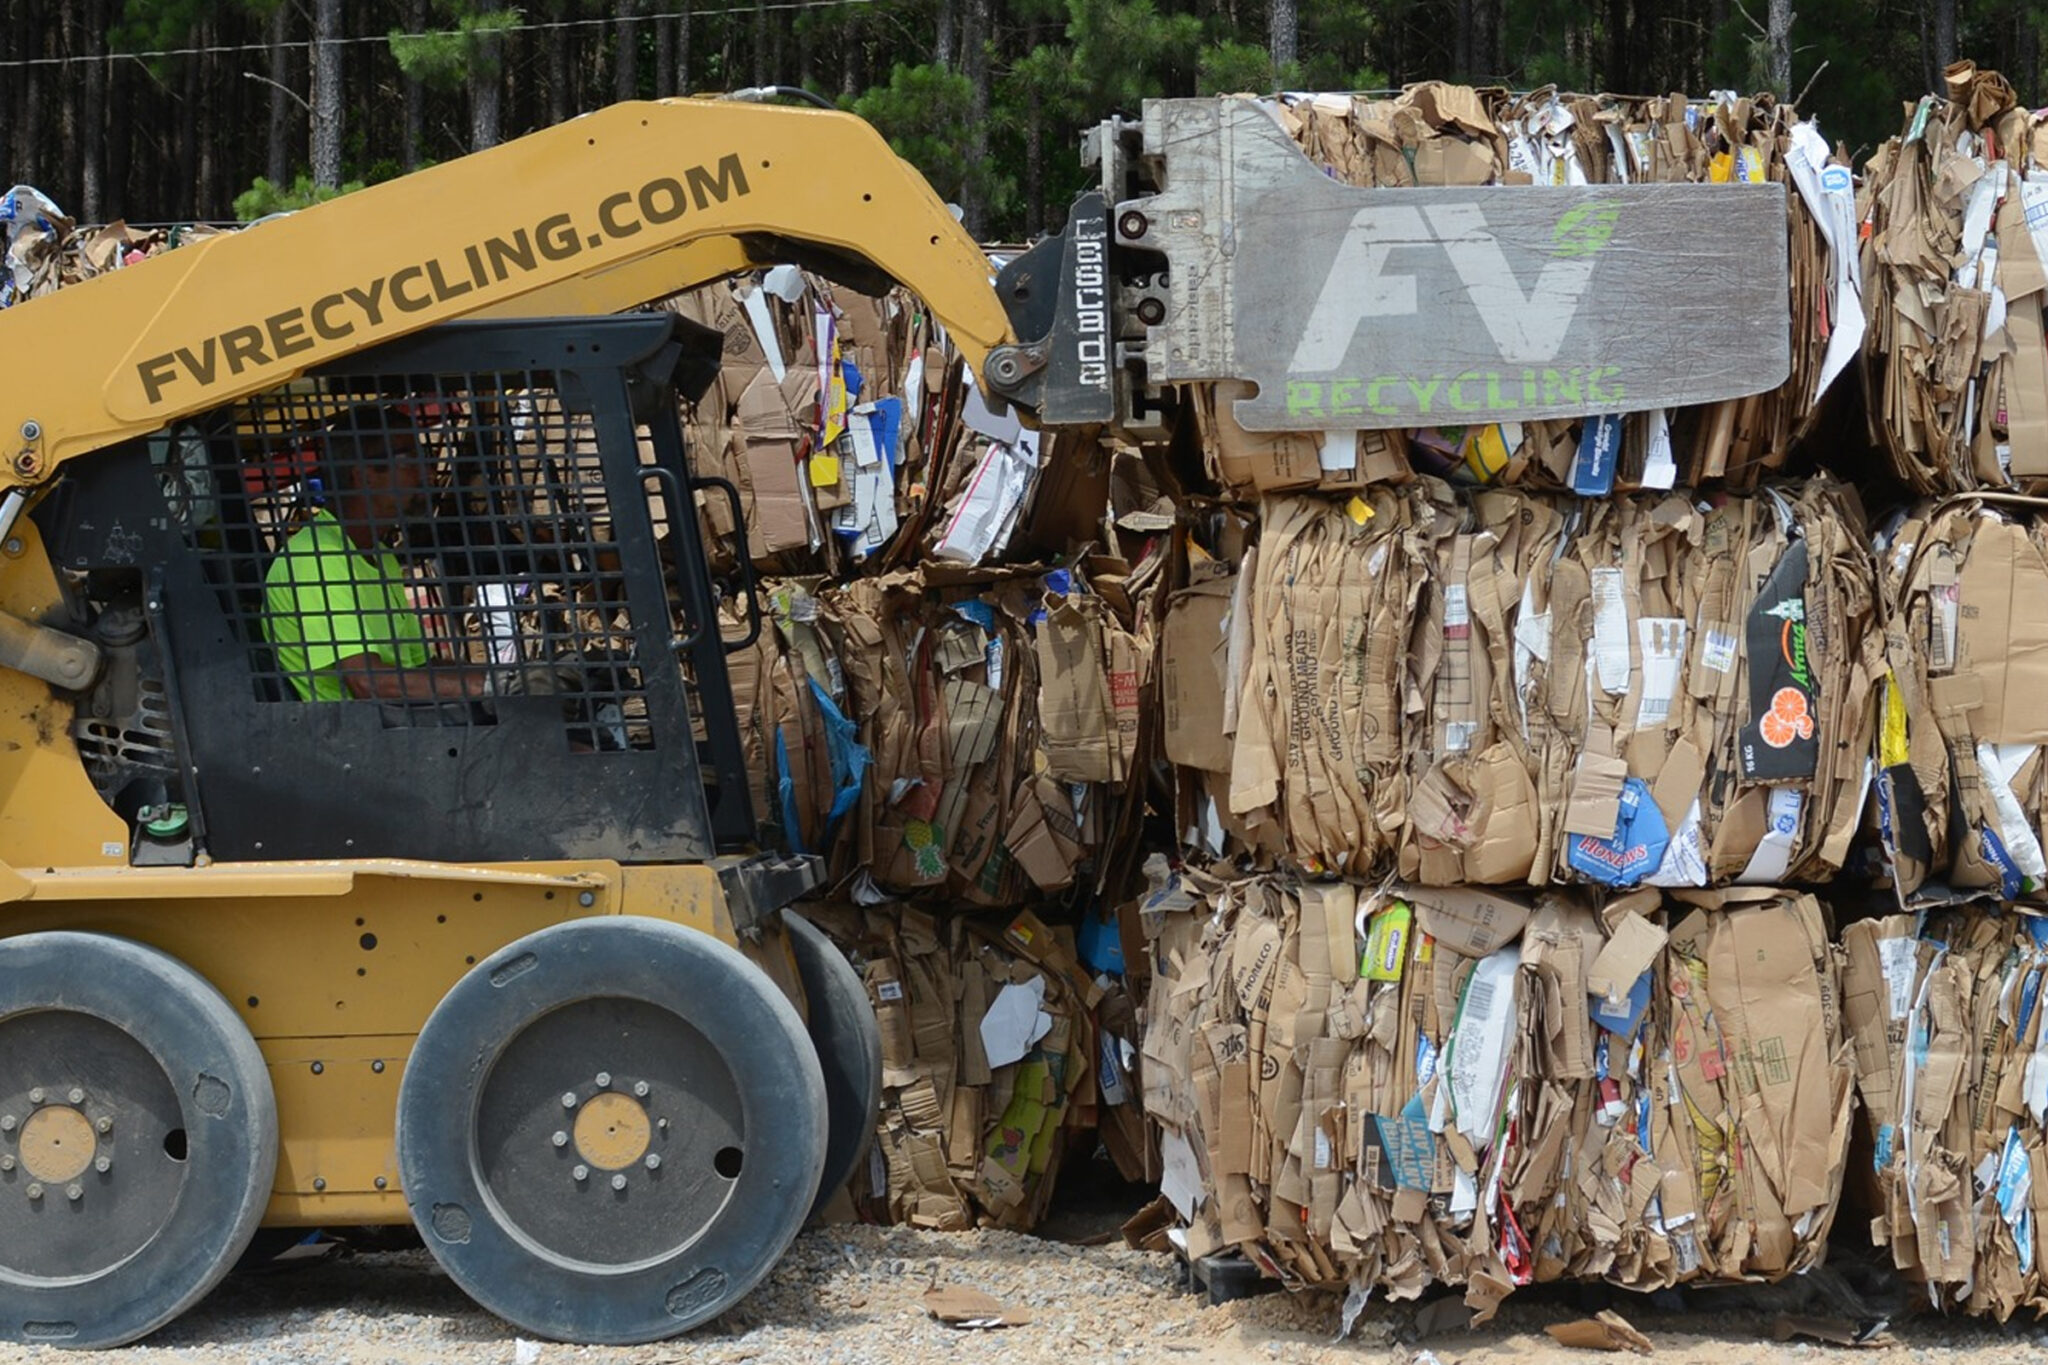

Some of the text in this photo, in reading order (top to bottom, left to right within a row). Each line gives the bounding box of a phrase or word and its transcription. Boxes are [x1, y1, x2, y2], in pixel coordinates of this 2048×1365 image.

[137, 153, 750, 405] FVRECYCLING.COM
[1287, 202, 1596, 373] FV
[1286, 365, 1626, 418] RECYCLING
[1789, 623, 1811, 694] Aroma
[1744, 744, 1756, 774] 16 KG
[1243, 942, 1273, 993] NORELCO
[1656, 1086, 1665, 1101] UP
